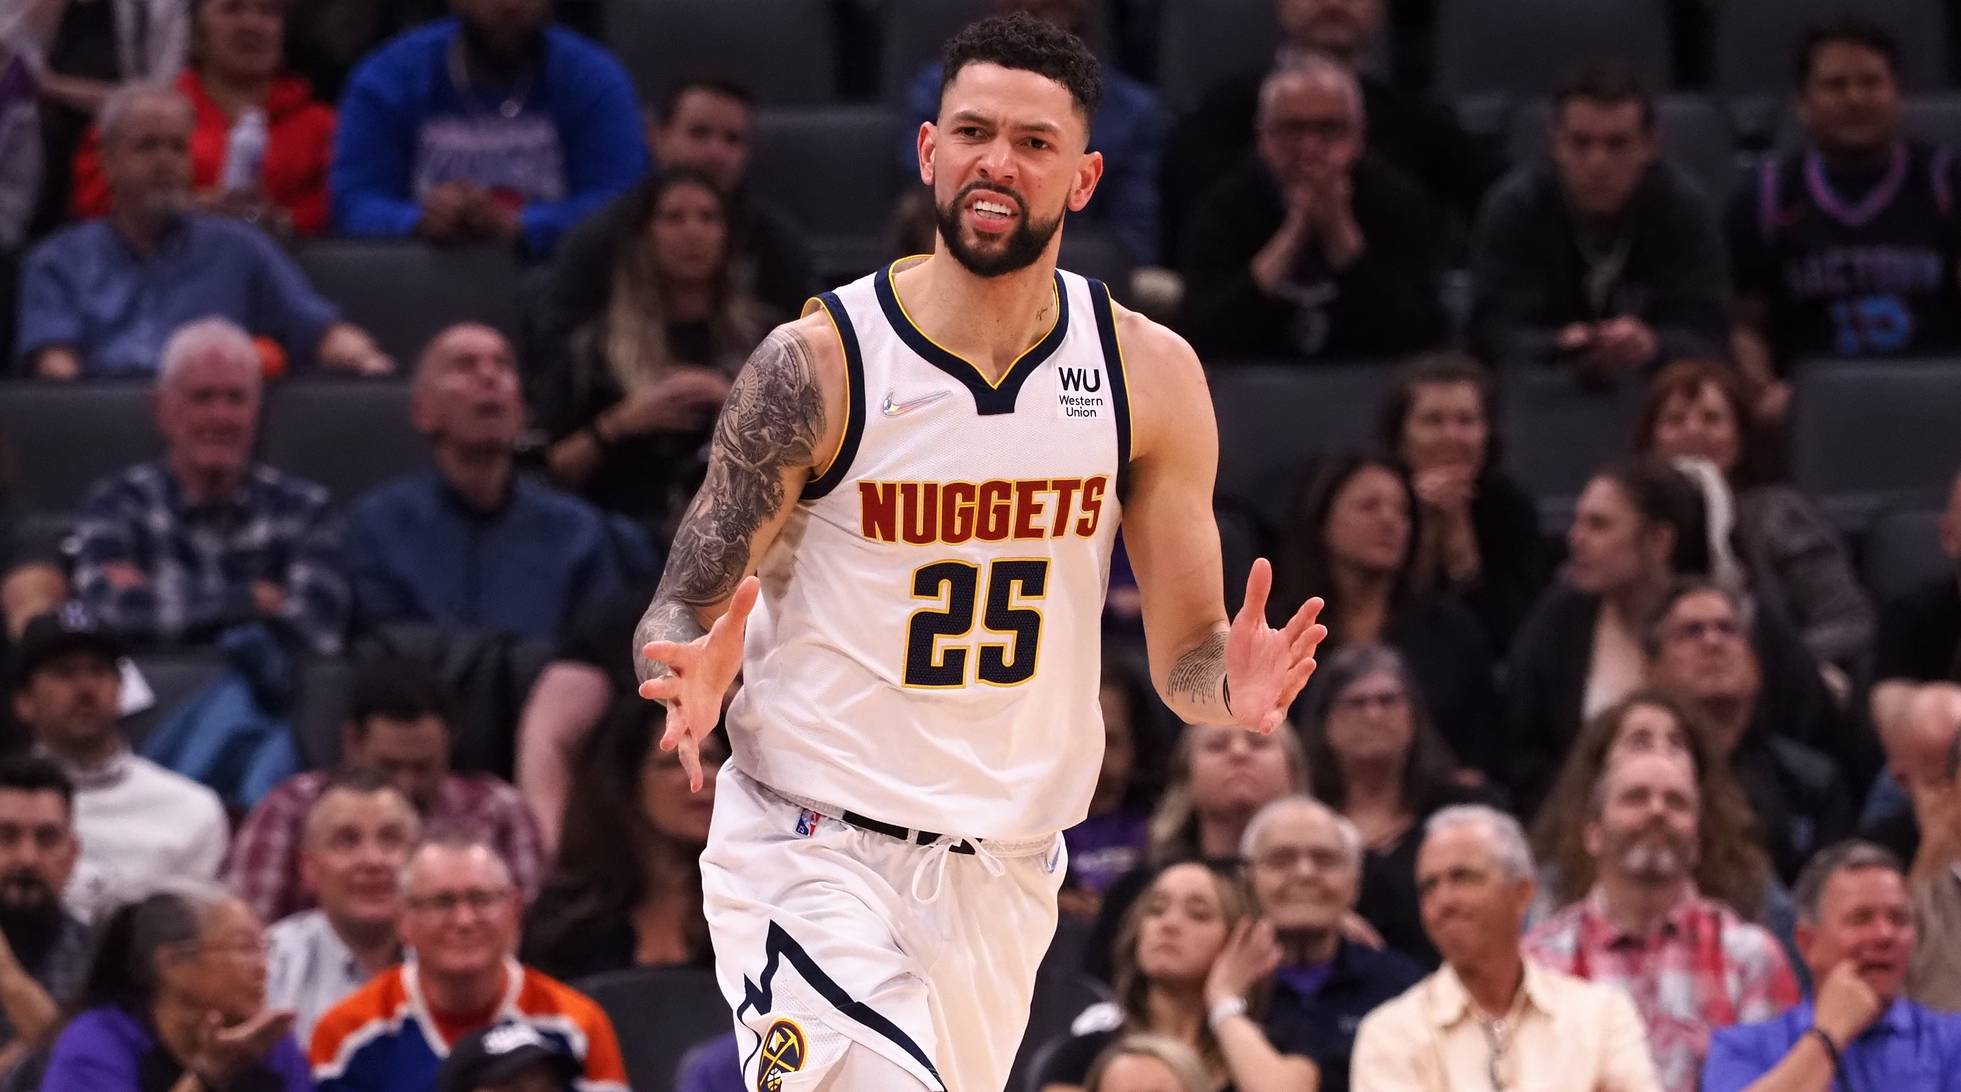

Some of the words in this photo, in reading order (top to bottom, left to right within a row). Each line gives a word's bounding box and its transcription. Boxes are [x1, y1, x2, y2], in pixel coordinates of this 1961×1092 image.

[1058, 366, 1101, 392] WU
[1059, 394, 1103, 406] Western
[1066, 406, 1097, 417] Union
[857, 476, 1108, 544] NUGGETS
[902, 556, 1051, 689] 25
